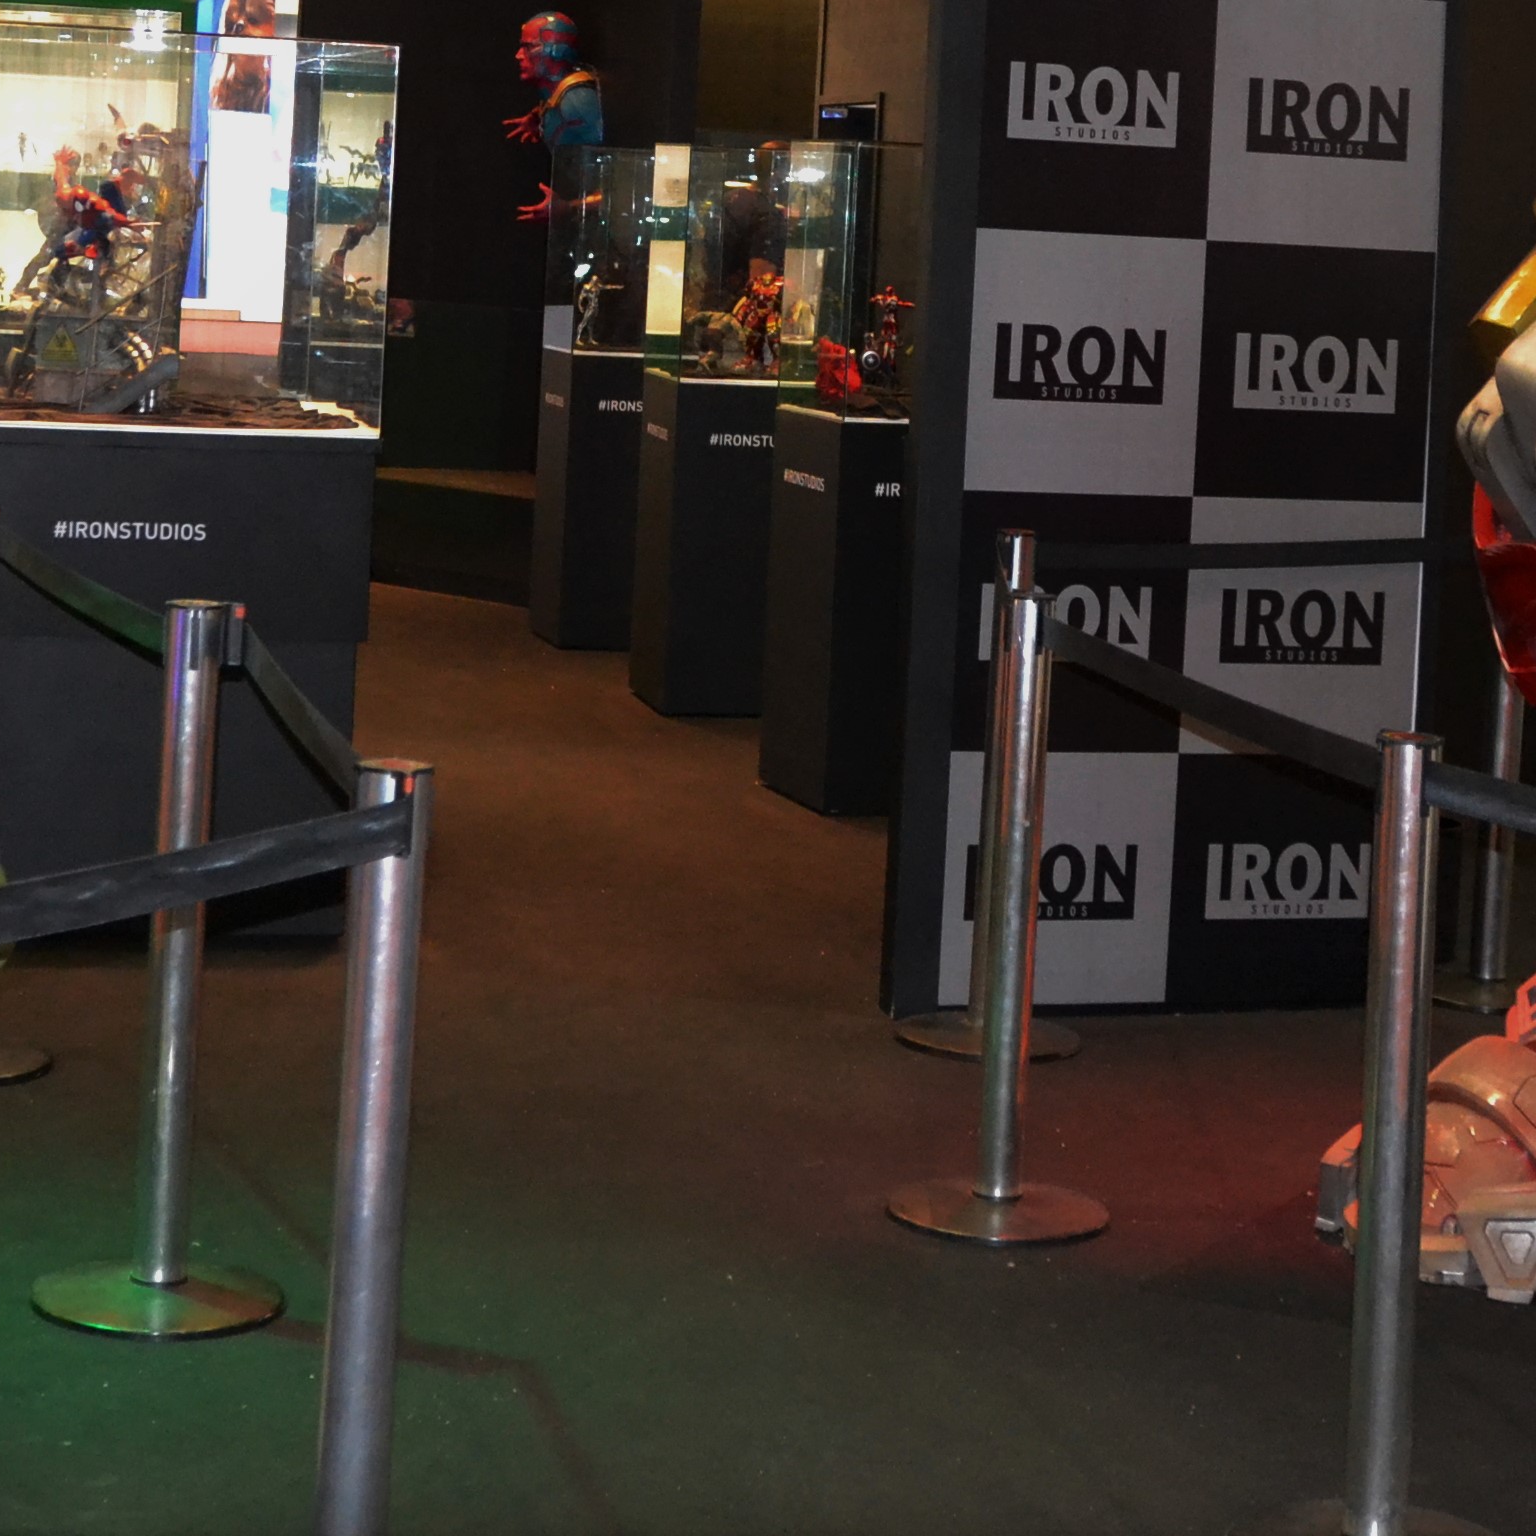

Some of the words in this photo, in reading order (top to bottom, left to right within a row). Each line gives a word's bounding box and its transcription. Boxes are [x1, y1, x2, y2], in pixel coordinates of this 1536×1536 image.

[1008, 61, 1179, 133] IRON
[1247, 78, 1410, 147] IRON
[1054, 126, 1132, 142] STUDIOS
[1290, 140, 1365, 156] STUDIOS
[994, 323, 1166, 390] IRON
[1234, 333, 1398, 399] IRON
[1040, 385, 1119, 400] STUDIOS
[1278, 395, 1353, 410] STUDIOS
[54, 521, 207, 541] #IRONSTUDIOS
[978, 583, 1152, 660] ION
[1220, 589, 1385, 650] IRON
[1264, 649, 1339, 662] STUDIOS
[964, 843, 1138, 911] ION
[1205, 843, 1371, 903] IRON
[1250, 903, 1326, 916] STUDIOS
